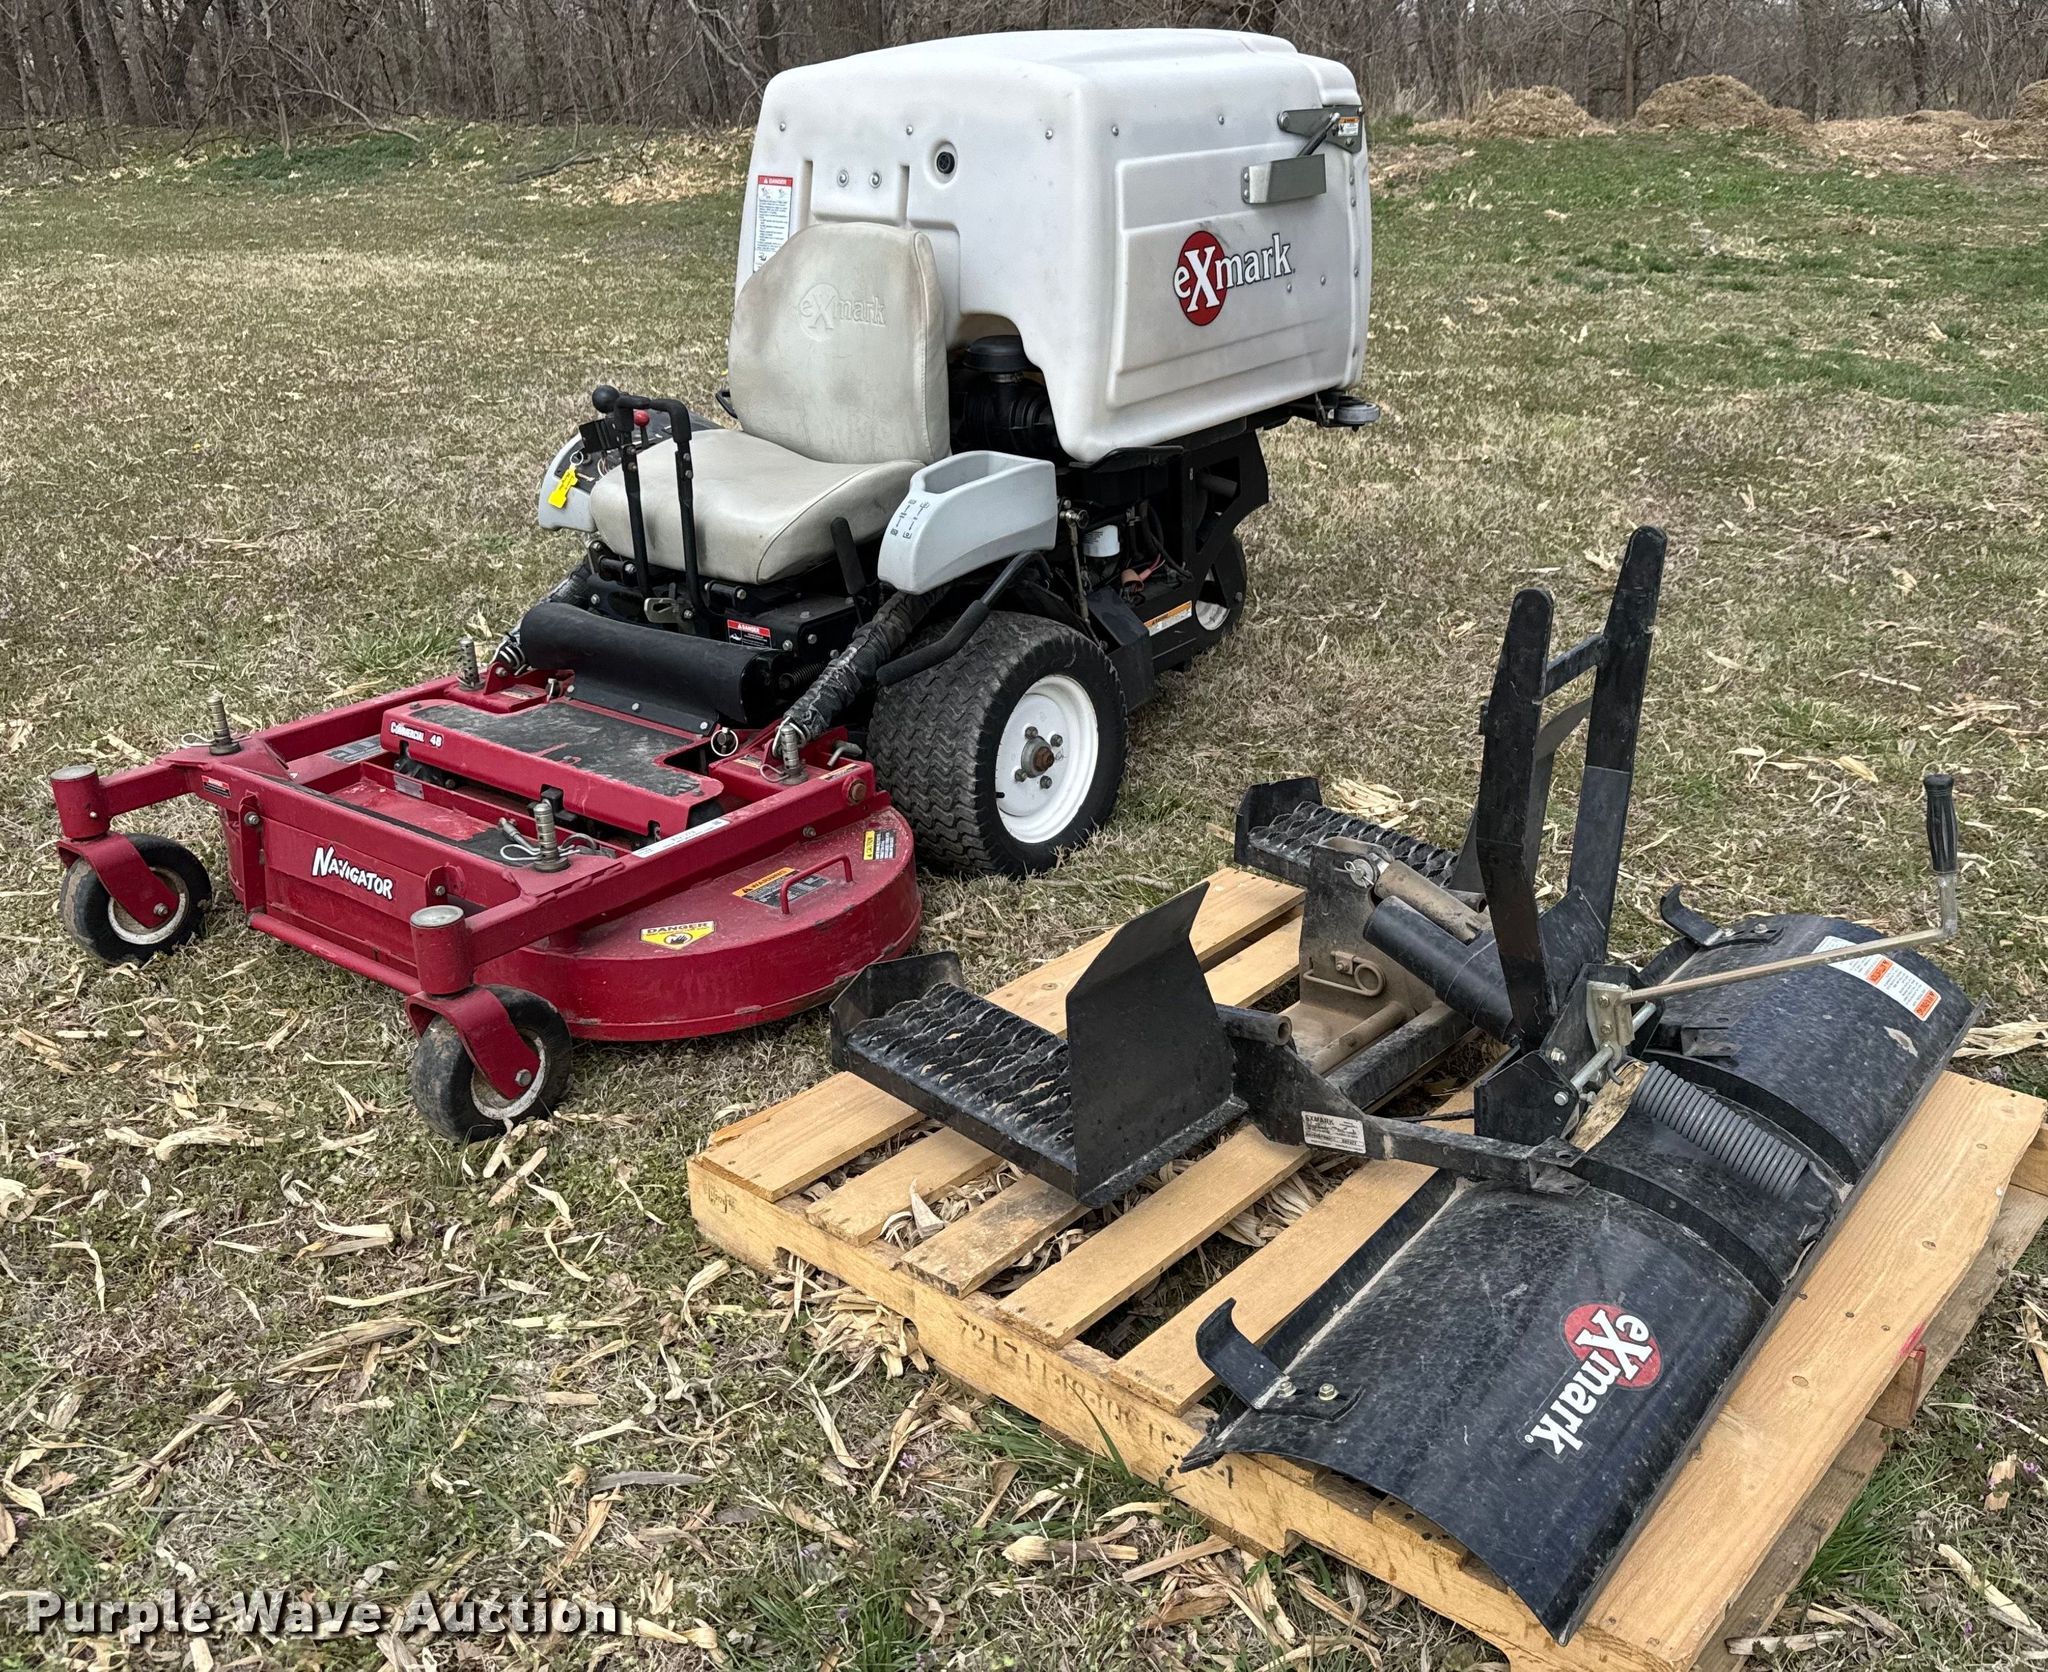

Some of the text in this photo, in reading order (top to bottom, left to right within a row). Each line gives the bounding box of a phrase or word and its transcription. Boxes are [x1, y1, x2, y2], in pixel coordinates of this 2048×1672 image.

[1173, 233, 1292, 312] eXmark
[799, 293, 886, 330] eXmark
[430, 734, 443, 747] 48
[312, 846, 393, 900] NAVIGATOR
[647, 923, 708, 935] DANGER
[1529, 1309, 1653, 1455] eXmark
